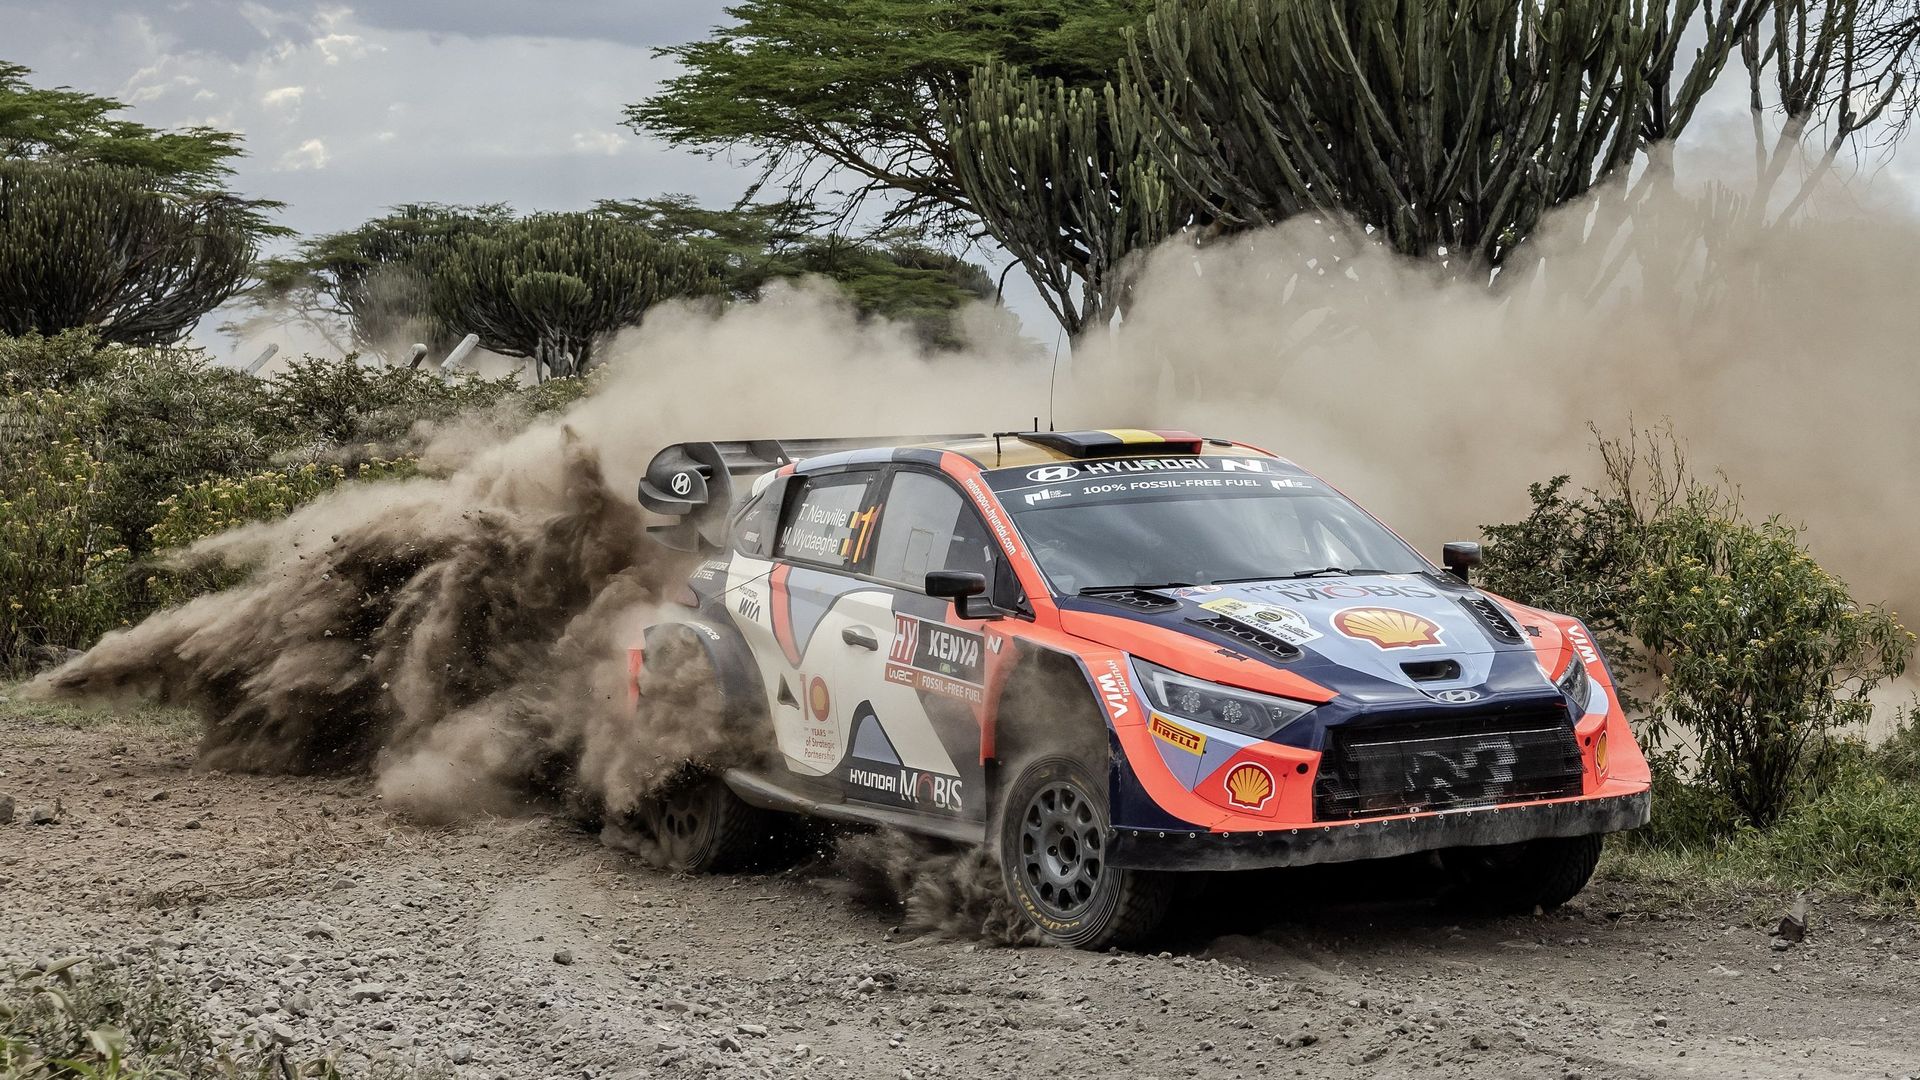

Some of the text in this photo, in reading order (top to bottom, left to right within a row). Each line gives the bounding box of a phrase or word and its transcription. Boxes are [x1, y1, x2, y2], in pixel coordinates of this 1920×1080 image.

[1084, 459, 1210, 475] HYUNDAI
[1083, 483, 1127, 495] 100%
[1130, 480, 1222, 490] FOSSIL-FREE
[1225, 479, 1262, 487] FUEL
[799, 503, 847, 527] T. Neuville
[966, 478, 1017, 556] motorsport.hyundai.com
[792, 529, 838, 556] Wydaeghe
[1240, 580, 1349, 593] HYUNDAI
[1278, 584, 1438, 603] MOBIS
[738, 597, 761, 622] WIA
[890, 618, 980, 668] HY KENYA
[1254, 622, 1276, 634] KENYA
[1276, 631, 1297, 642] 2024
[1567, 624, 1598, 664] WIA
[888, 667, 914, 684] WRC
[1107, 659, 1131, 696] HYUNDAI
[921, 675, 982, 703] FOSSIL-FREE FUEL
[1097, 673, 1129, 719] WIA
[811, 727, 827, 737] YEARS
[1152, 717, 1201, 750] PIRELLI
[804, 747, 836, 761] Partnership
[805, 736, 836, 753] of Strategic
[849, 768, 963, 812] HYUNDAI MOBIS
